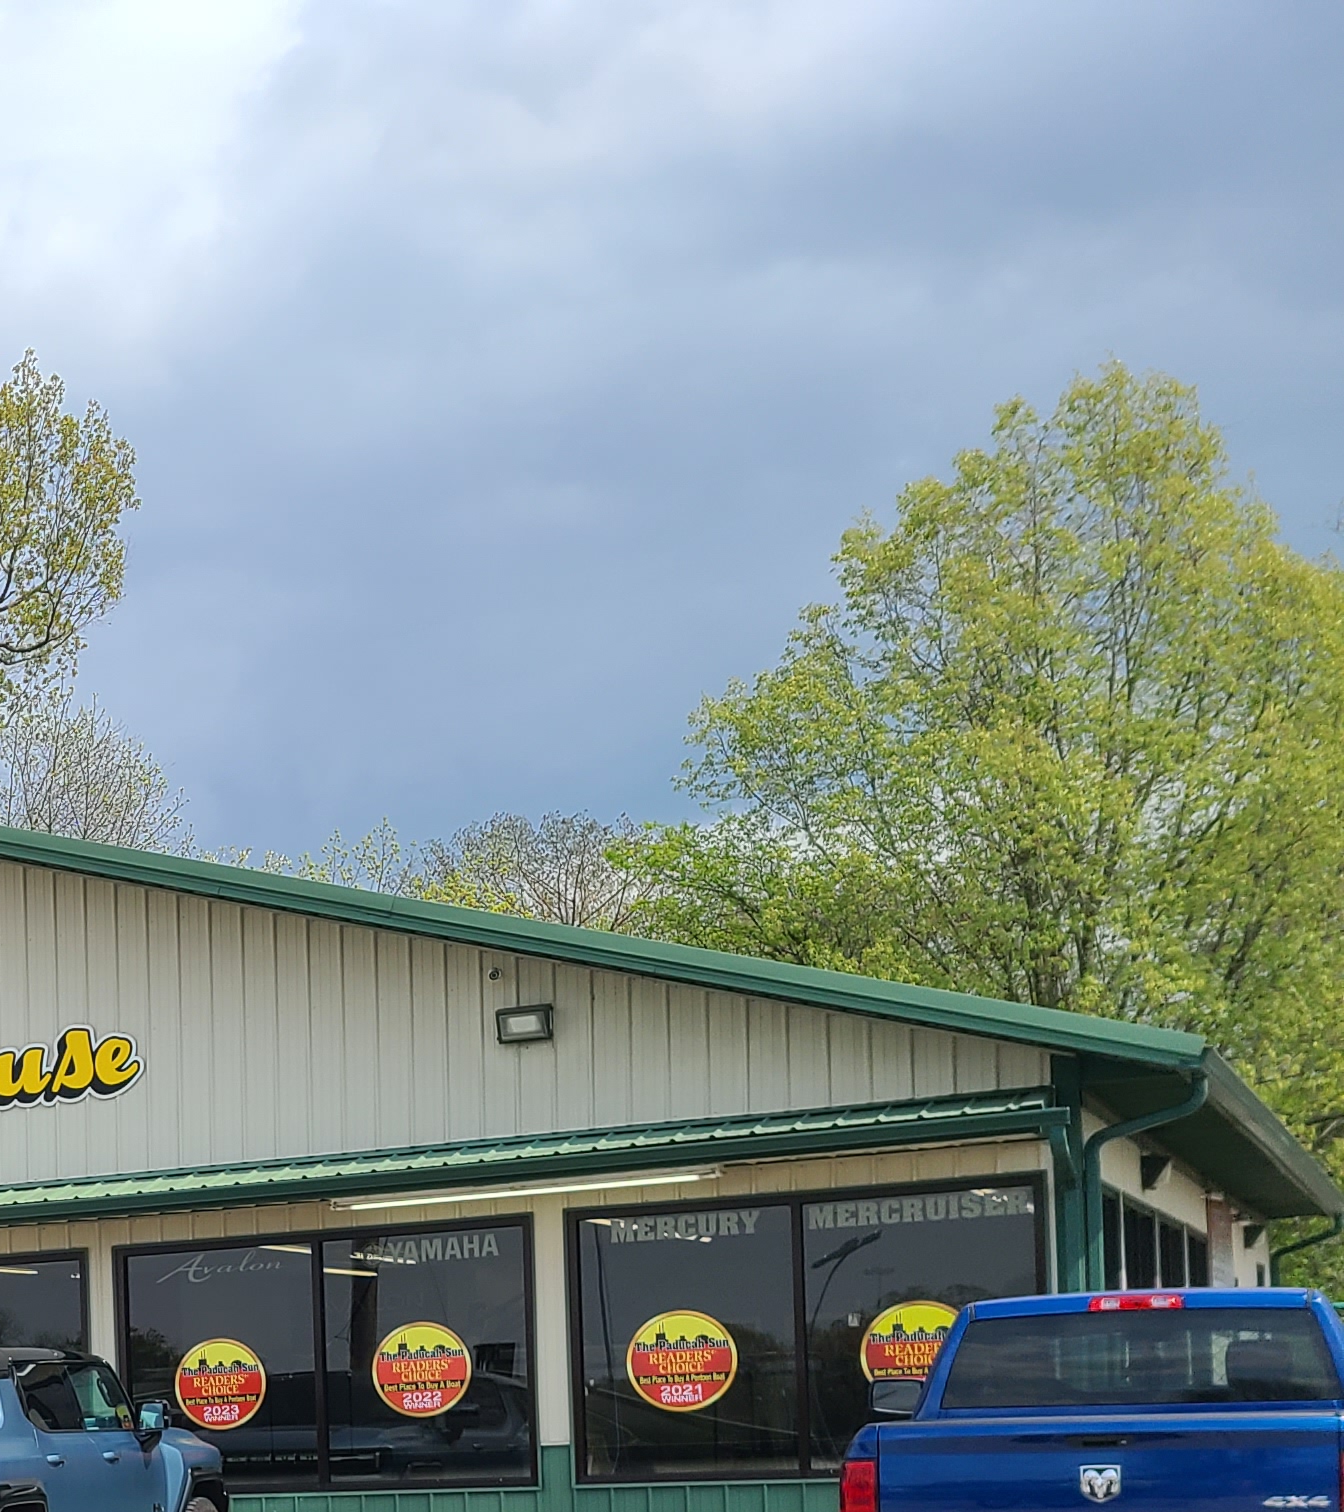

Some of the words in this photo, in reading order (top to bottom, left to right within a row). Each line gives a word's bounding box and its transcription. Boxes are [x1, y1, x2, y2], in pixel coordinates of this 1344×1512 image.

[808, 1187, 1032, 1231] MERCRUISER
[611, 1209, 761, 1244] MERCURY
[387, 1233, 499, 1263] YAMAHA
[156, 1252, 282, 1284] Avalon
[635, 1342, 655, 1352] The
[657, 1337, 705, 1350] Paducah
[708, 1337, 730, 1348] Sun
[870, 1333, 892, 1345] The
[380, 1351, 399, 1362] The
[399, 1347, 443, 1360] Paducah
[444, 1347, 465, 1357] Sun
[182, 1366, 199, 1376] The
[200, 1363, 240, 1375] Paducah
[241, 1362, 259, 1372] Sun
[658, 1361, 704, 1374] CHOICE
[400, 1370, 442, 1382] CHOICE
[201, 1384, 240, 1396] CHOICE
[660, 1384, 702, 1396] 2021
[403, 1391, 442, 1402] 2022
[203, 1404, 240, 1415] 2023
[403, 1400, 441, 1409] WINNER
[204, 1413, 239, 1422] WINNER
